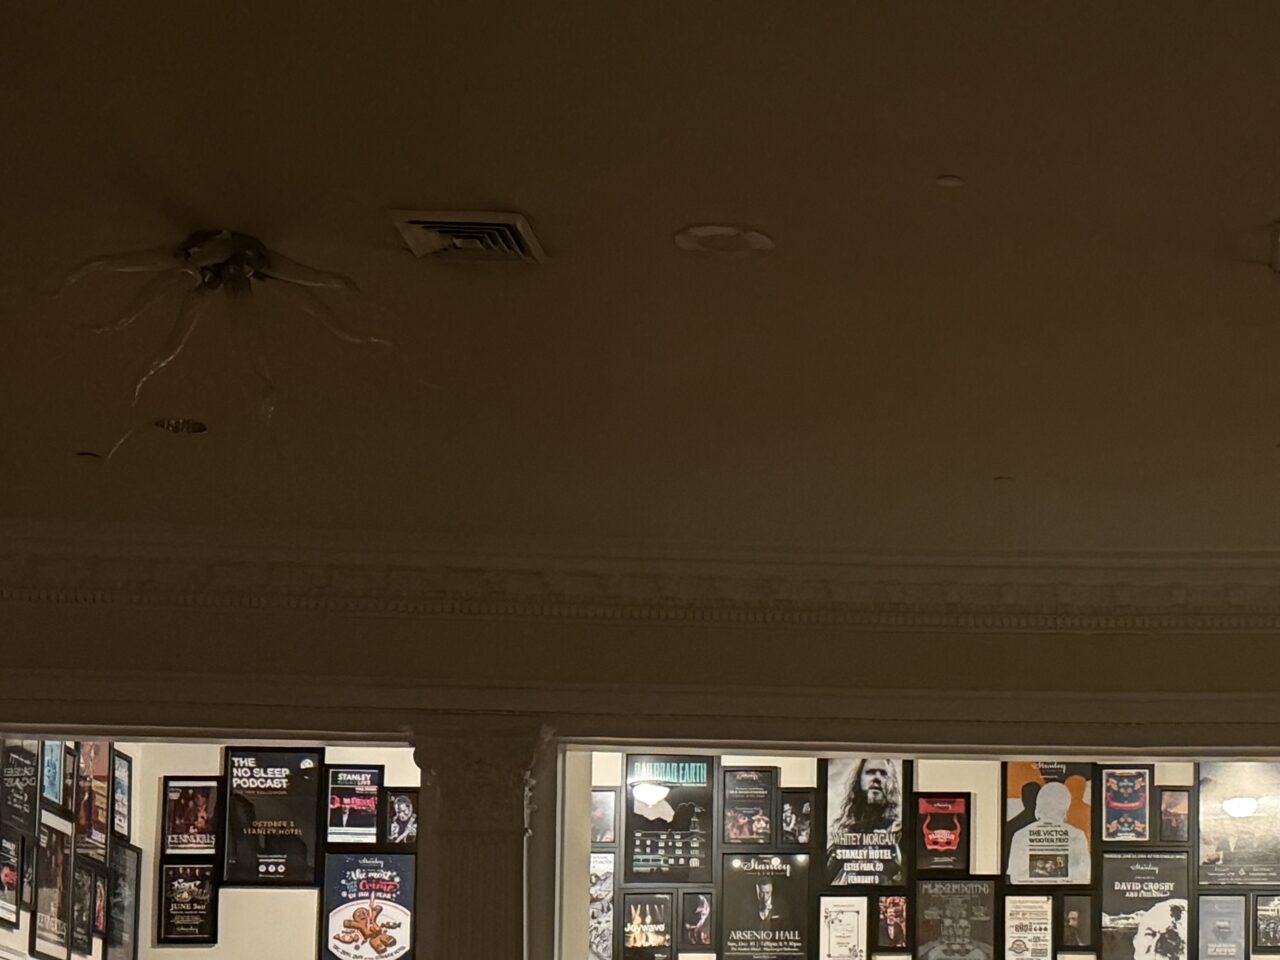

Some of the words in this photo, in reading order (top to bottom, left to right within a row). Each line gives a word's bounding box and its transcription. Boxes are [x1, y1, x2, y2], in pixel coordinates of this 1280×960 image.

[232, 757, 256, 767] THE
[232, 768, 251, 777] NO
[253, 768, 290, 777] SLEEP
[680, 762, 707, 783] EARTH
[232, 779, 289, 788] PODCAST
[833, 833, 862, 845] WHITEY
[862, 833, 896, 845] MORGAN
[836, 849, 868, 859] STANLEY
[868, 849, 892, 859] HOTEL
[1113, 881, 1141, 890] DAVID
[1142, 882, 1175, 891] CROSBY
[729, 931, 773, 940] ARSENIO
[775, 931, 801, 940] HALL
